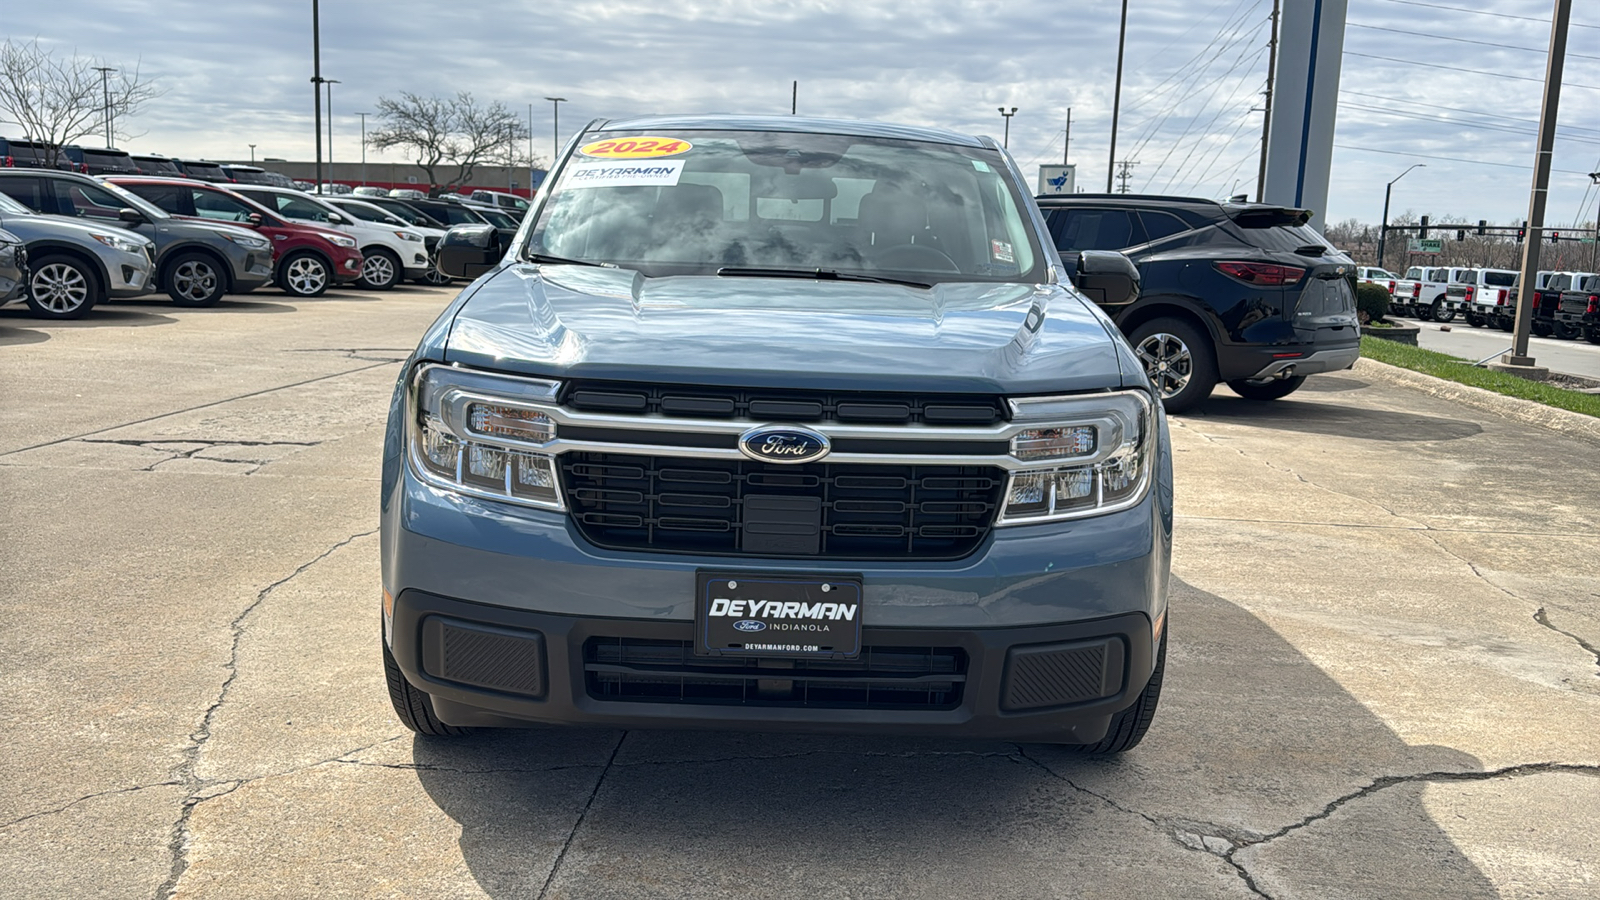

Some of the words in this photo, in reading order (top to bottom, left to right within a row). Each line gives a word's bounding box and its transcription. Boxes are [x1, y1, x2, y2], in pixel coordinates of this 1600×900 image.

[589, 141, 681, 154] 2024
[573, 167, 676, 178] DEYARMAN
[761, 434, 808, 455] Ford
[709, 598, 857, 621] DEYARMAN
[739, 621, 760, 630] Ford
[769, 623, 830, 632] INDIANOLA
[745, 643, 818, 651] DEYARMANFORD.COM
